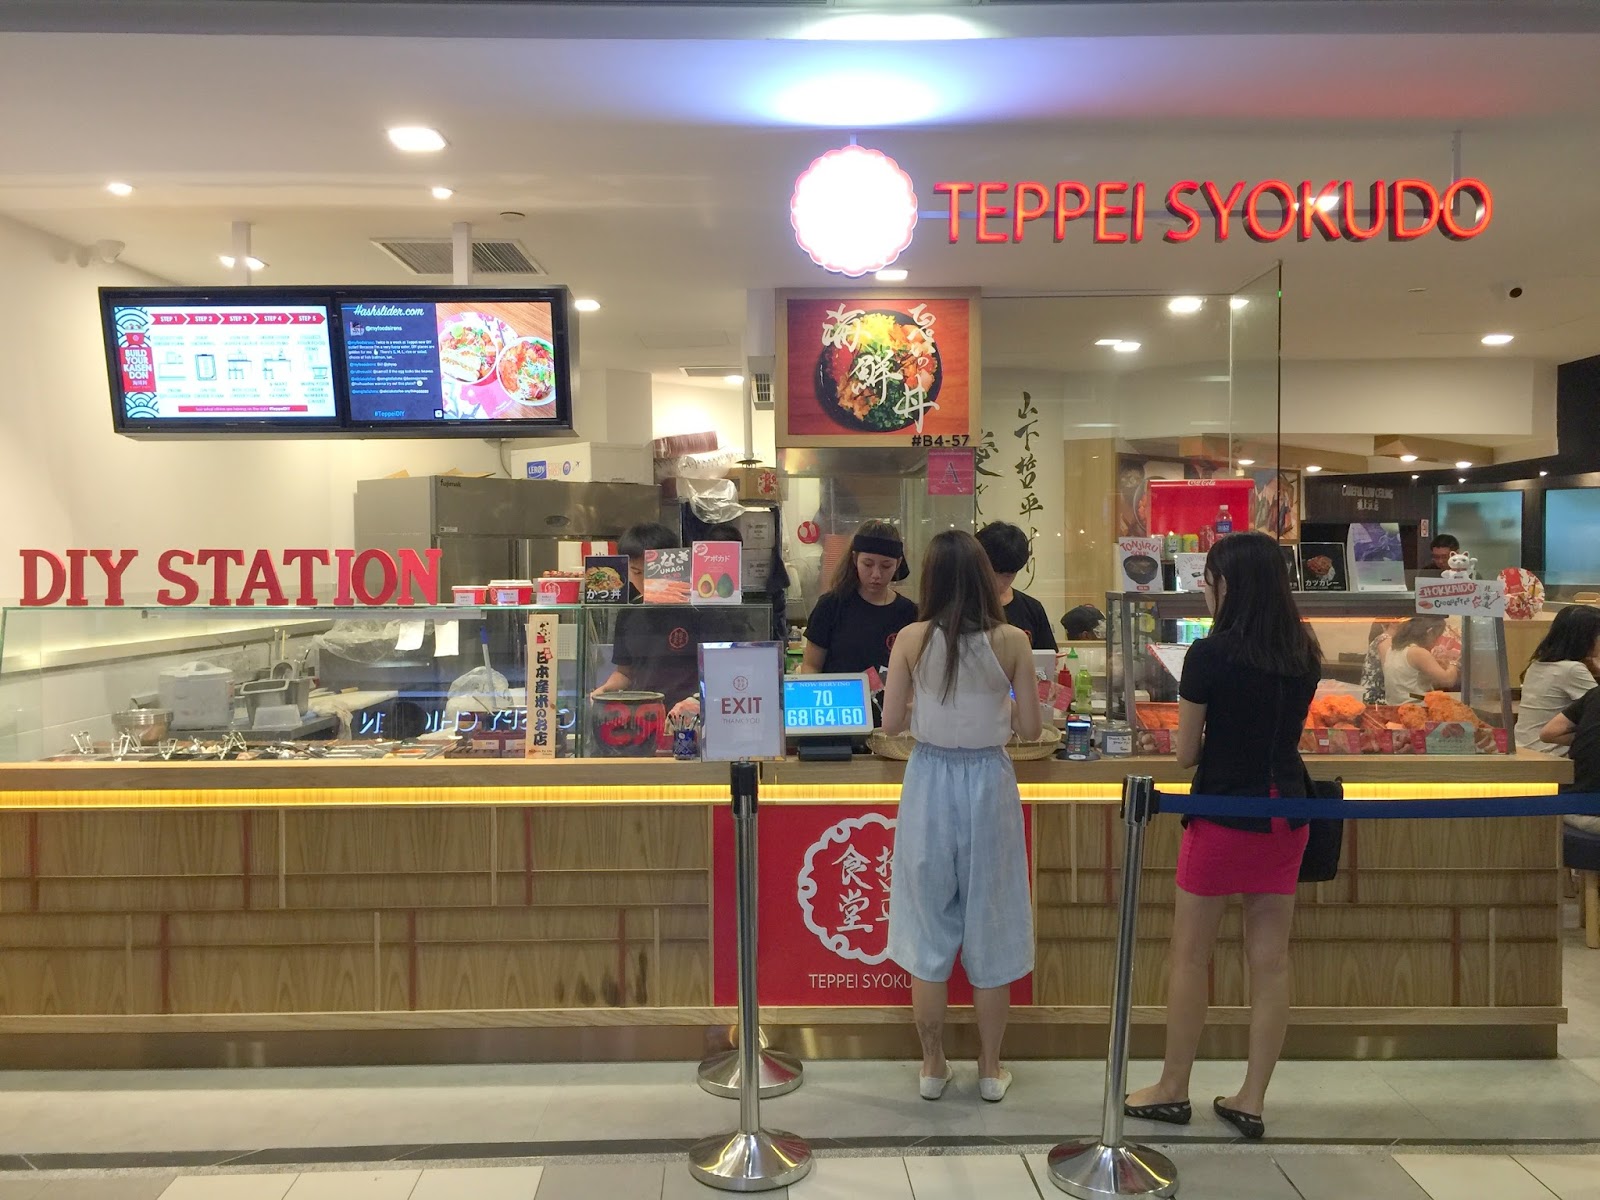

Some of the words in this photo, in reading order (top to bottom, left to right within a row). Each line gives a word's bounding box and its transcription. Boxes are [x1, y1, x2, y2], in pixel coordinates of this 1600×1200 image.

[933, 180, 1146, 243] TEPPEI
[1162, 178, 1495, 242] SYOKUDO
[129, 372, 148, 380] DON
[911, 434, 970, 447] #B4-57
[939, 461, 961, 484] A
[1120, 540, 1159, 553] TONJIRU
[647, 549, 690, 578] うなぎ
[660, 566, 685, 575] UNAGI
[19, 548, 138, 606] DIY
[156, 548, 442, 606] STATION
[586, 588, 622, 600] かつ丼
[1422, 583, 1475, 597] HOKKAIDO
[721, 696, 762, 714] EXIT
[812, 690, 833, 706] 70
[787, 709, 808, 726] 68
[814, 708, 836, 726] 64
[842, 708, 863, 725] 60
[832, 844, 874, 934] 食堂
[808, 974, 858, 988] TEPPEI
[862, 973, 912, 988] SYOKU
